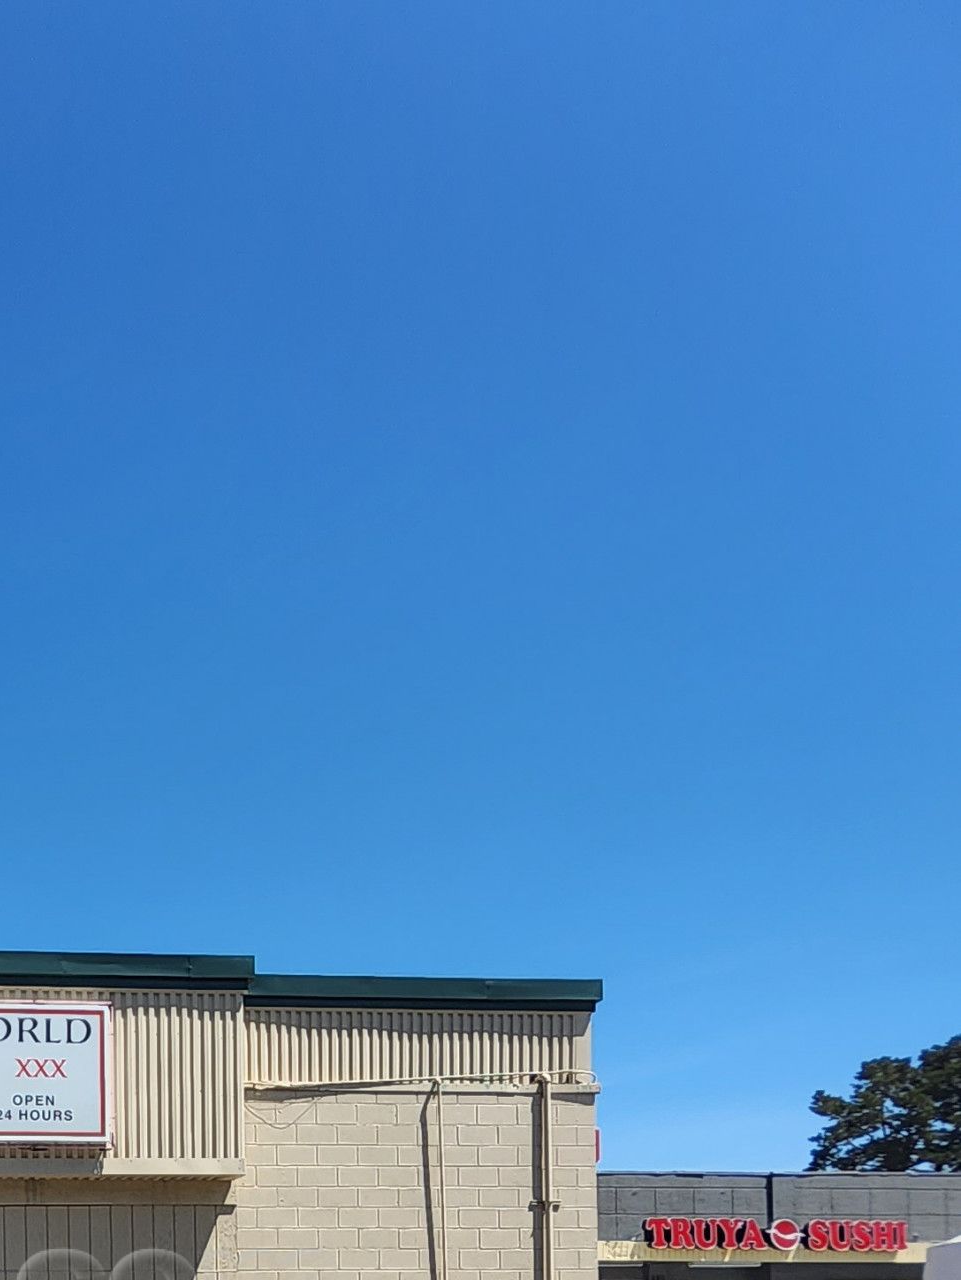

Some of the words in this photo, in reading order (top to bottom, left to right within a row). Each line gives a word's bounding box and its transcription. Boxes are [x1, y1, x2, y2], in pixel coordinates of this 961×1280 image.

[14, 1058, 68, 1078] XXX
[12, 1094, 55, 1106] OPEN
[18, 1109, 74, 1122] HOURS
[645, 1218, 766, 1250] TRUYA
[807, 1219, 909, 1252] SUSHI
